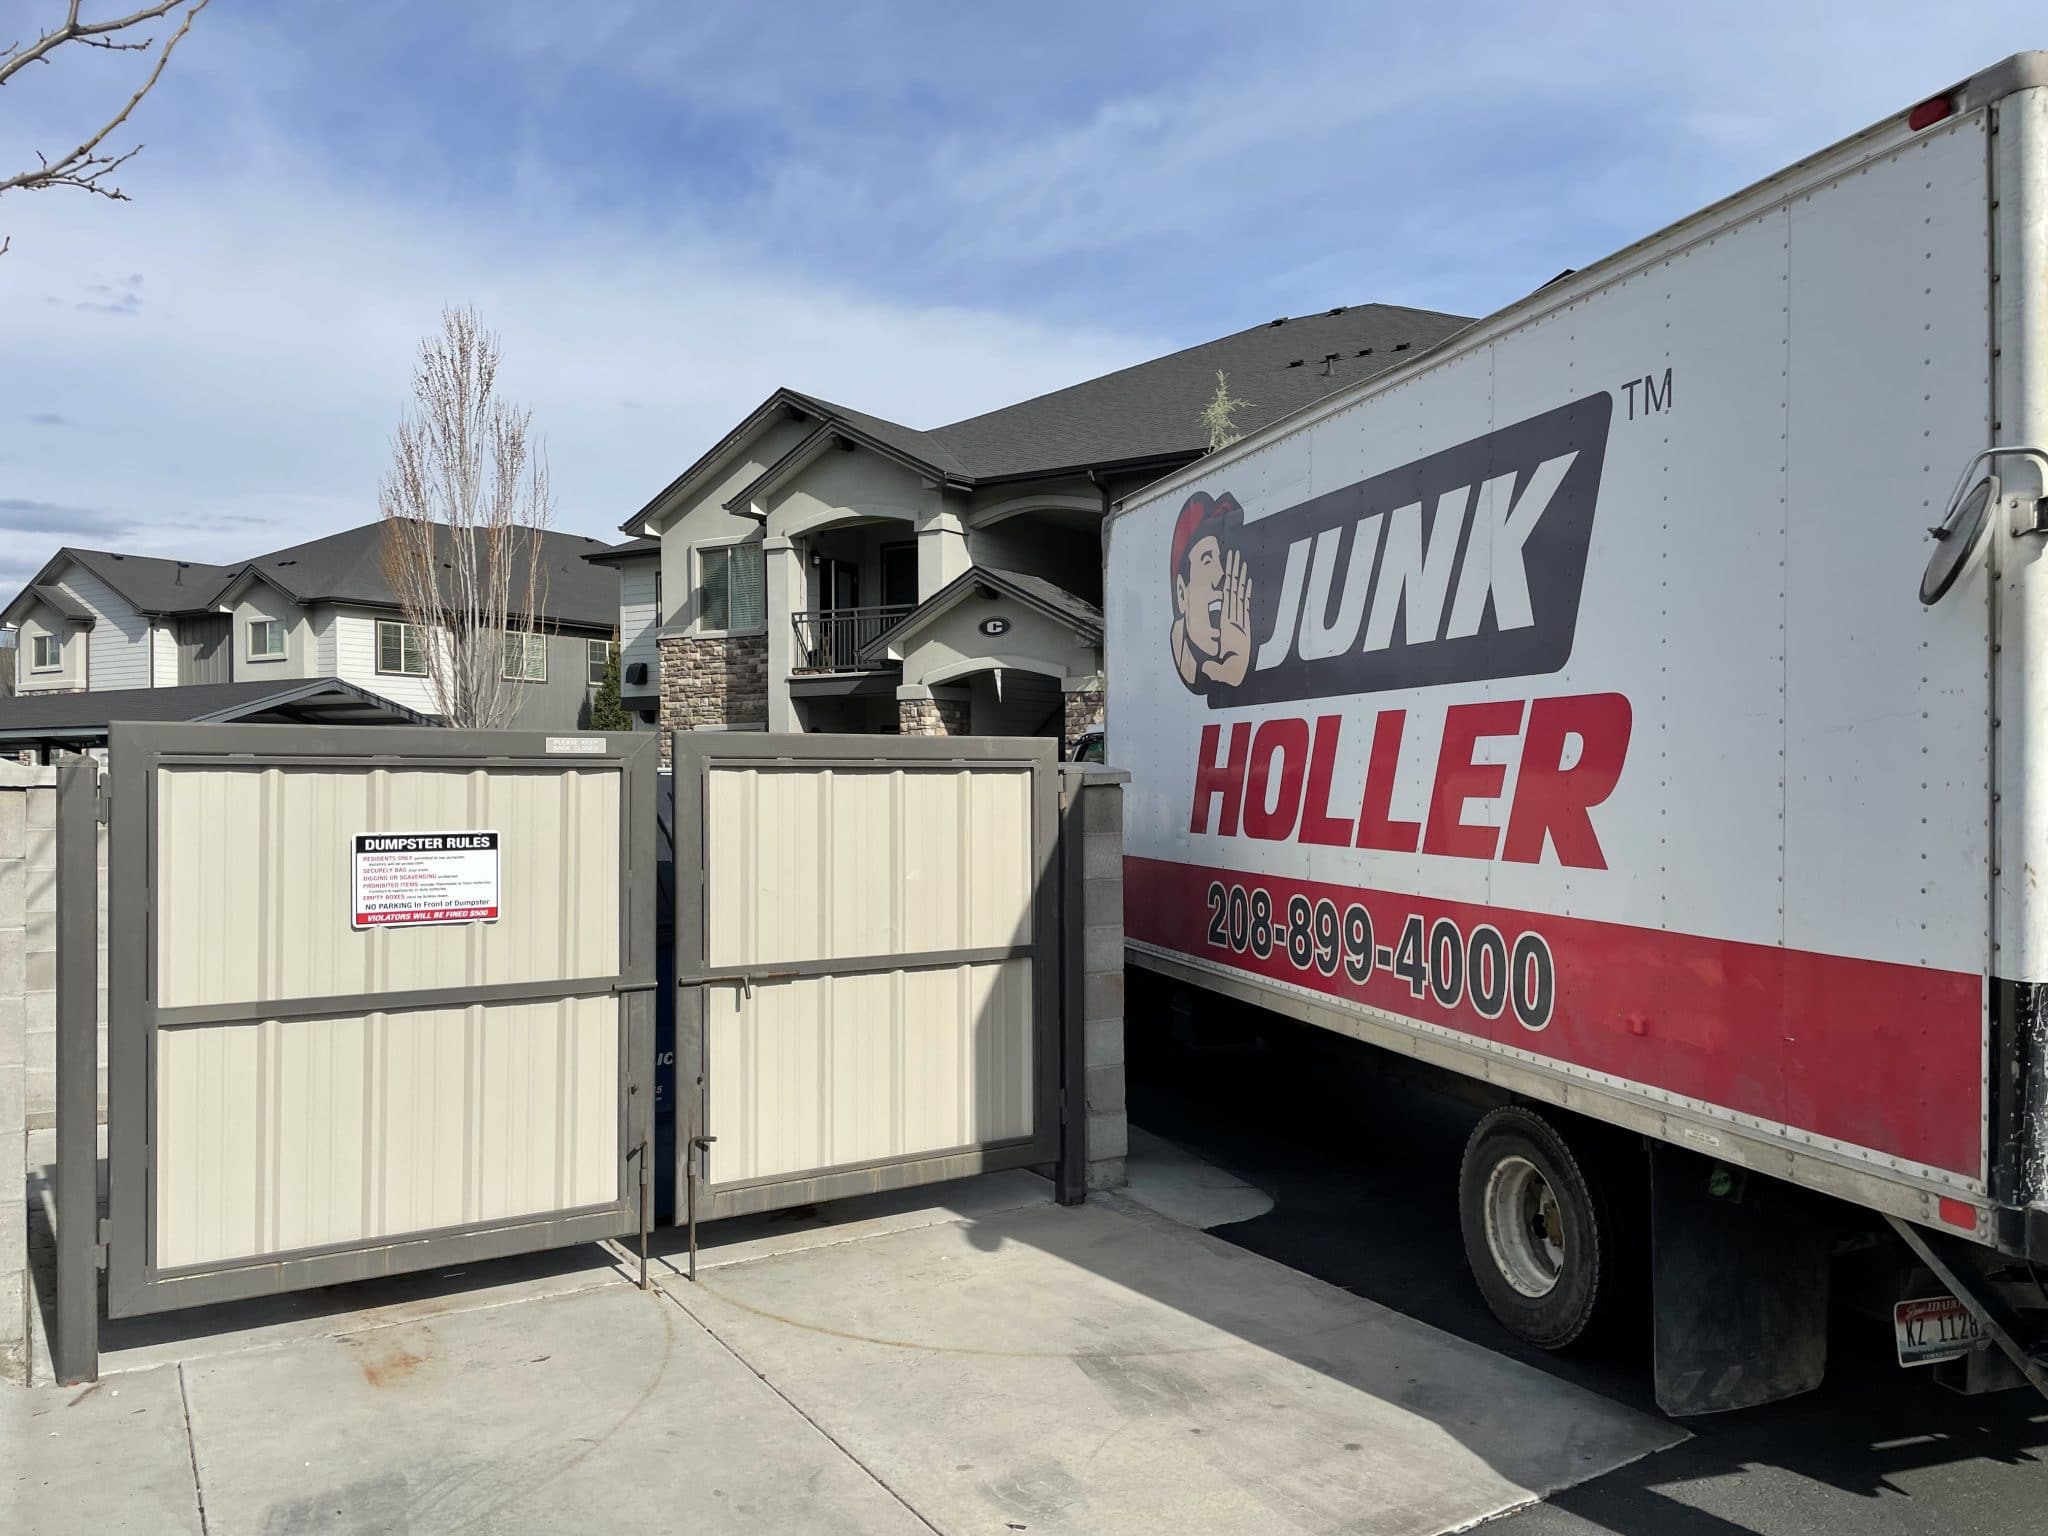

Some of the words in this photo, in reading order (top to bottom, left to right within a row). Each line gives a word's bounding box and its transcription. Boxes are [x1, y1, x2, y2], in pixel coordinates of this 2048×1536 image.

[1621, 368, 1672, 421] TM
[1256, 451, 1579, 672] JUNK
[987, 621, 1002, 632] C
[1190, 692, 1632, 870] HOLLER
[365, 838, 441, 850] DUMPSTER
[447, 837, 490, 848] RULES
[367, 913, 410, 922] VIOLATORS
[446, 910, 468, 918] FINED
[469, 909, 488, 917] $500
[379, 902, 412, 910] PARKING
[454, 899, 489, 907] Dumpster
[1207, 880, 1555, 1032] 208-899-4000
[1905, 1319, 1926, 1347] KZ
